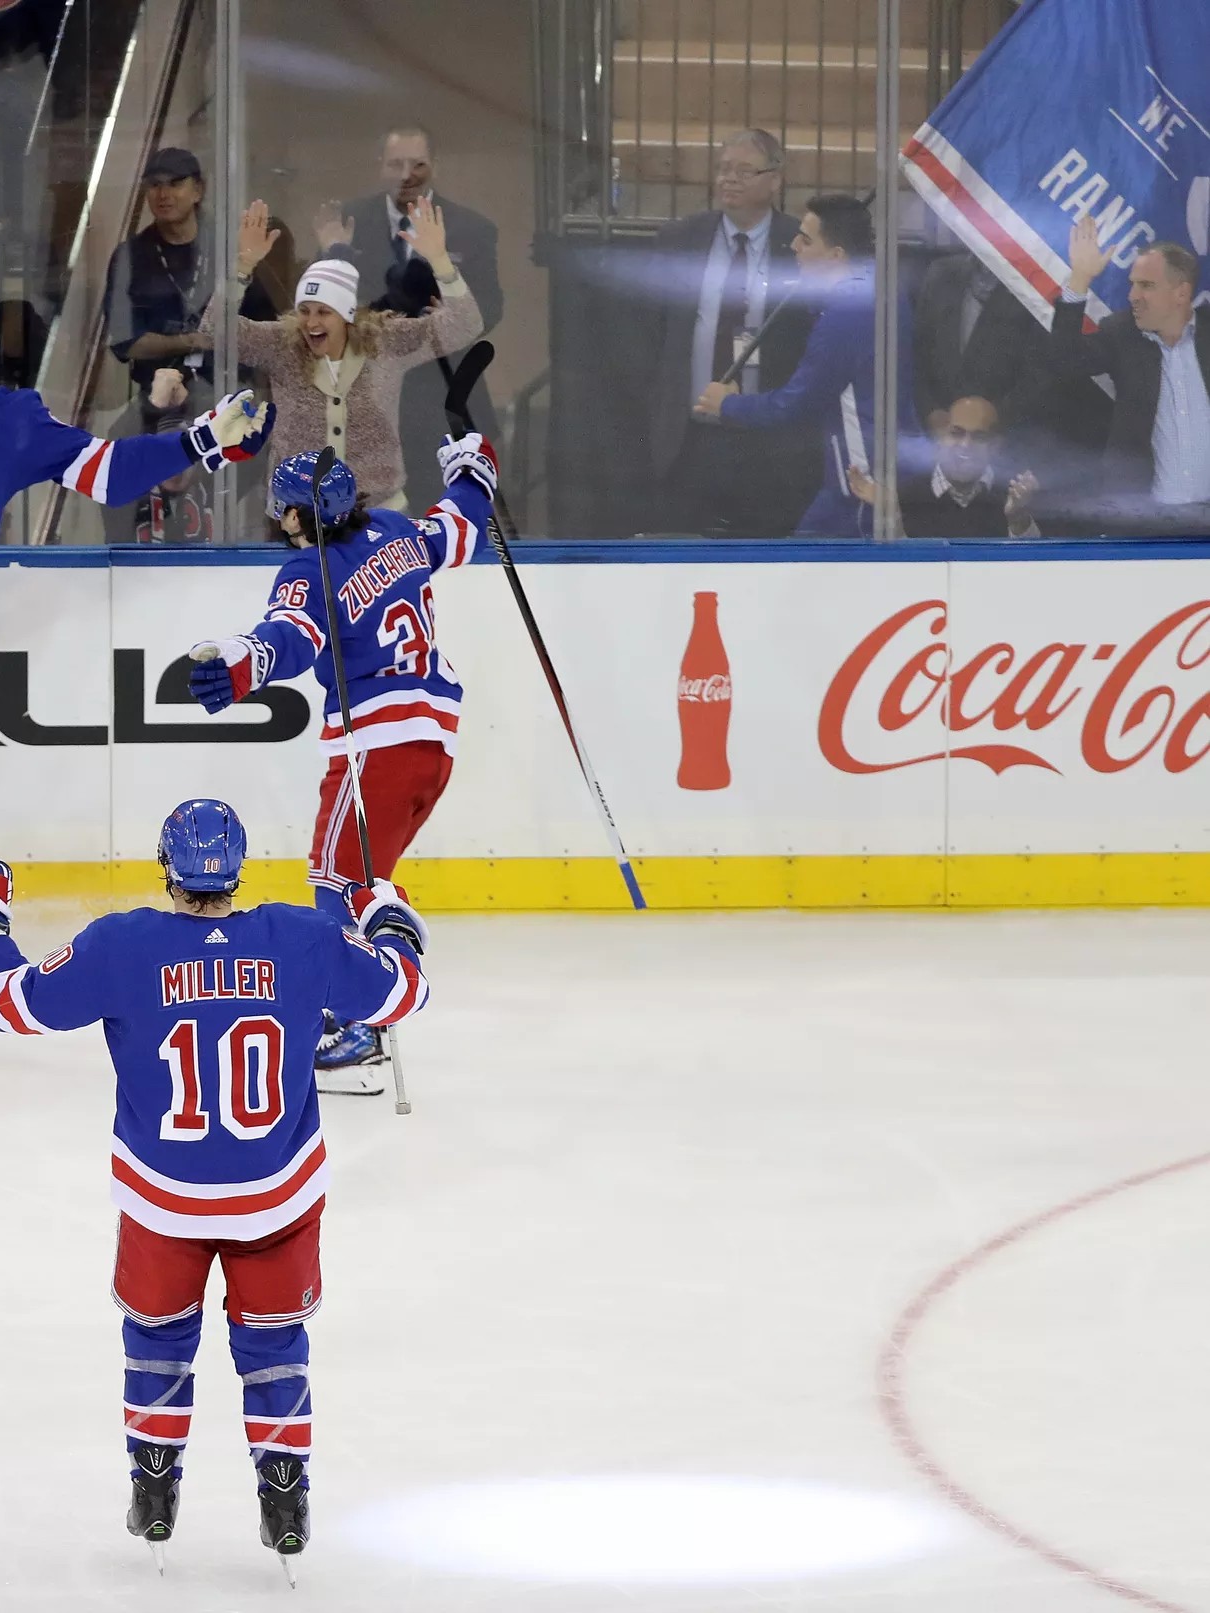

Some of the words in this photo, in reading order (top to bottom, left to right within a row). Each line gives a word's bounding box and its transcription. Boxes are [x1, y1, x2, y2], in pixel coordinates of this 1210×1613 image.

[203, 858, 221, 874] 10
[204, 936, 229, 944] adidas
[39, 942, 74, 975] 0
[160, 958, 276, 1007] MILLER
[158, 1014, 286, 1142] 10
